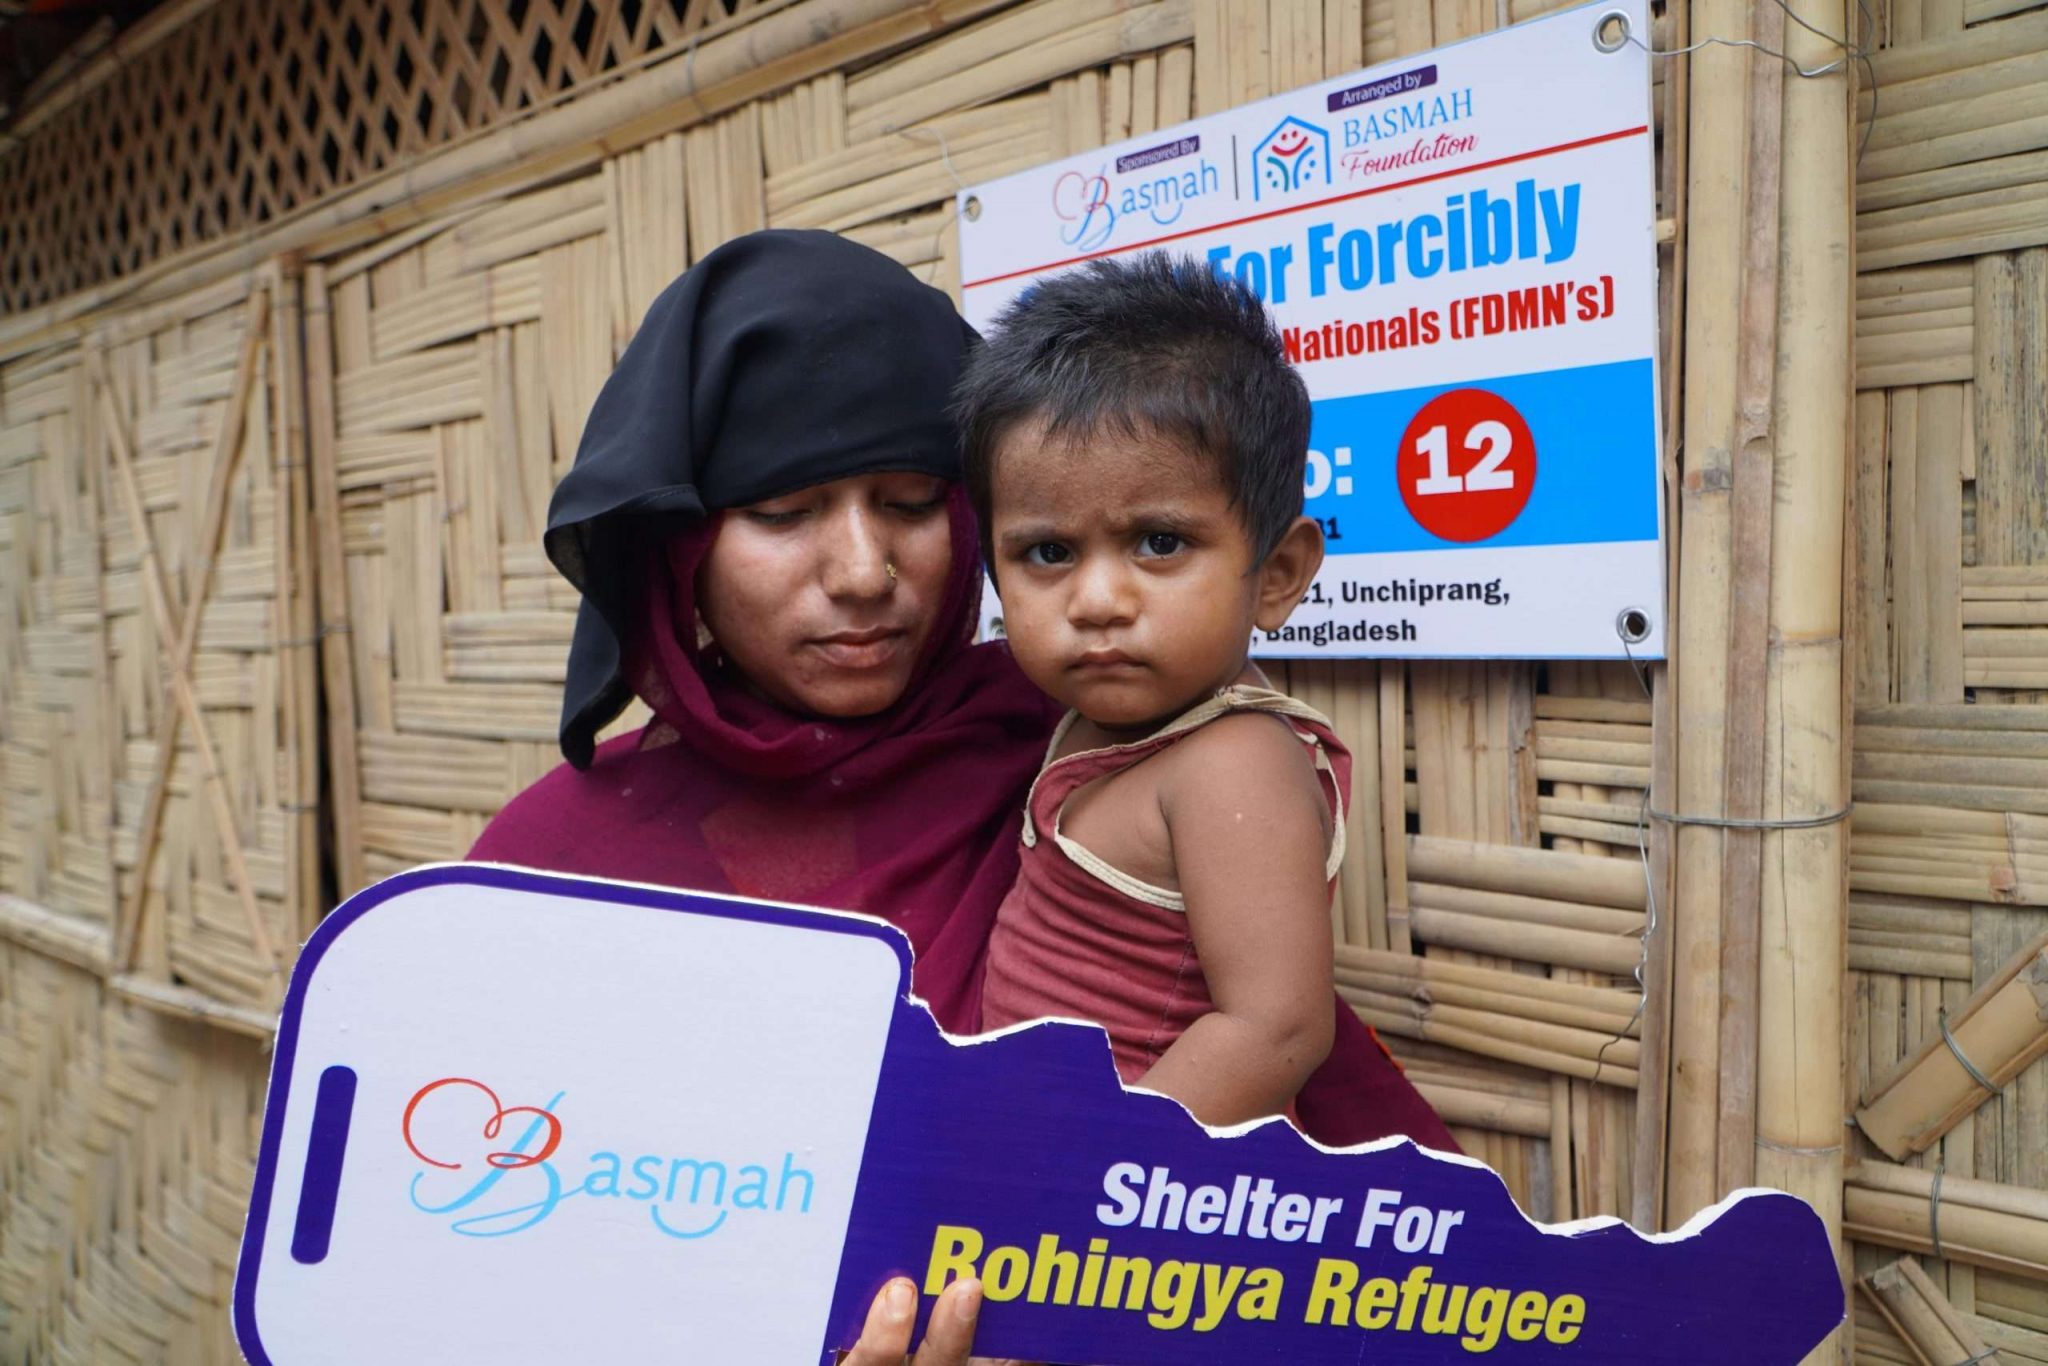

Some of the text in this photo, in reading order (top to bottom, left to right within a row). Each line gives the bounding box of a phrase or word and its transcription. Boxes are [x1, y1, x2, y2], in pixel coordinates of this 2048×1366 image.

[1342, 73, 1423, 106] Arranged by
[1343, 88, 1473, 148] BASMAH
[1117, 138, 1198, 171] Sponsored By
[1341, 133, 1479, 179] Foundation
[1053, 160, 1218, 251] Basmah
[1307, 178, 1581, 297] Forcibly
[1282, 275, 1615, 364] Nationals (FDMN's)
[1415, 420, 1514, 495] 12
[1341, 578, 1510, 606] Unchiprang,
[402, 1077, 815, 1240] Basmah
[1096, 1161, 1465, 1255] Shelter For
[923, 1225, 1586, 1353] Rohingya Refugee
